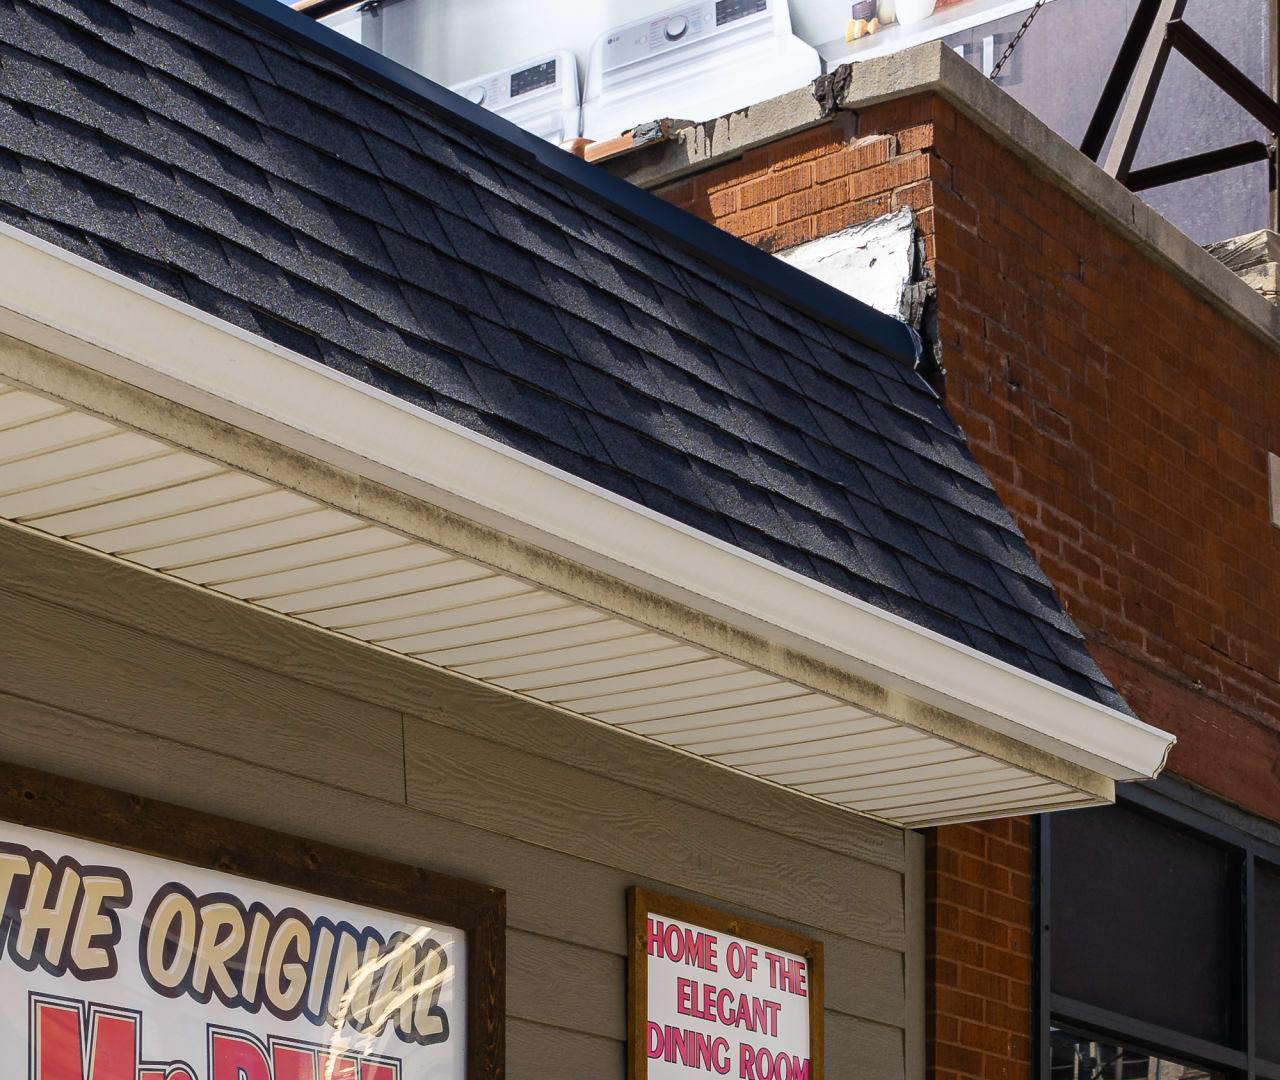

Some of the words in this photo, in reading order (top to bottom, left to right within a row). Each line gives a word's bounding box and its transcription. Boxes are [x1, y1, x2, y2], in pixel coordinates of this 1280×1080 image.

[139, 881, 450, 1047] ORIGINAL
[648, 918, 718, 974] HOME
[726, 941, 758, 982] OF
[765, 952, 807, 997] THE
[677, 976, 781, 1037] ELEGANT
[647, 1021, 730, 1075] DINING
